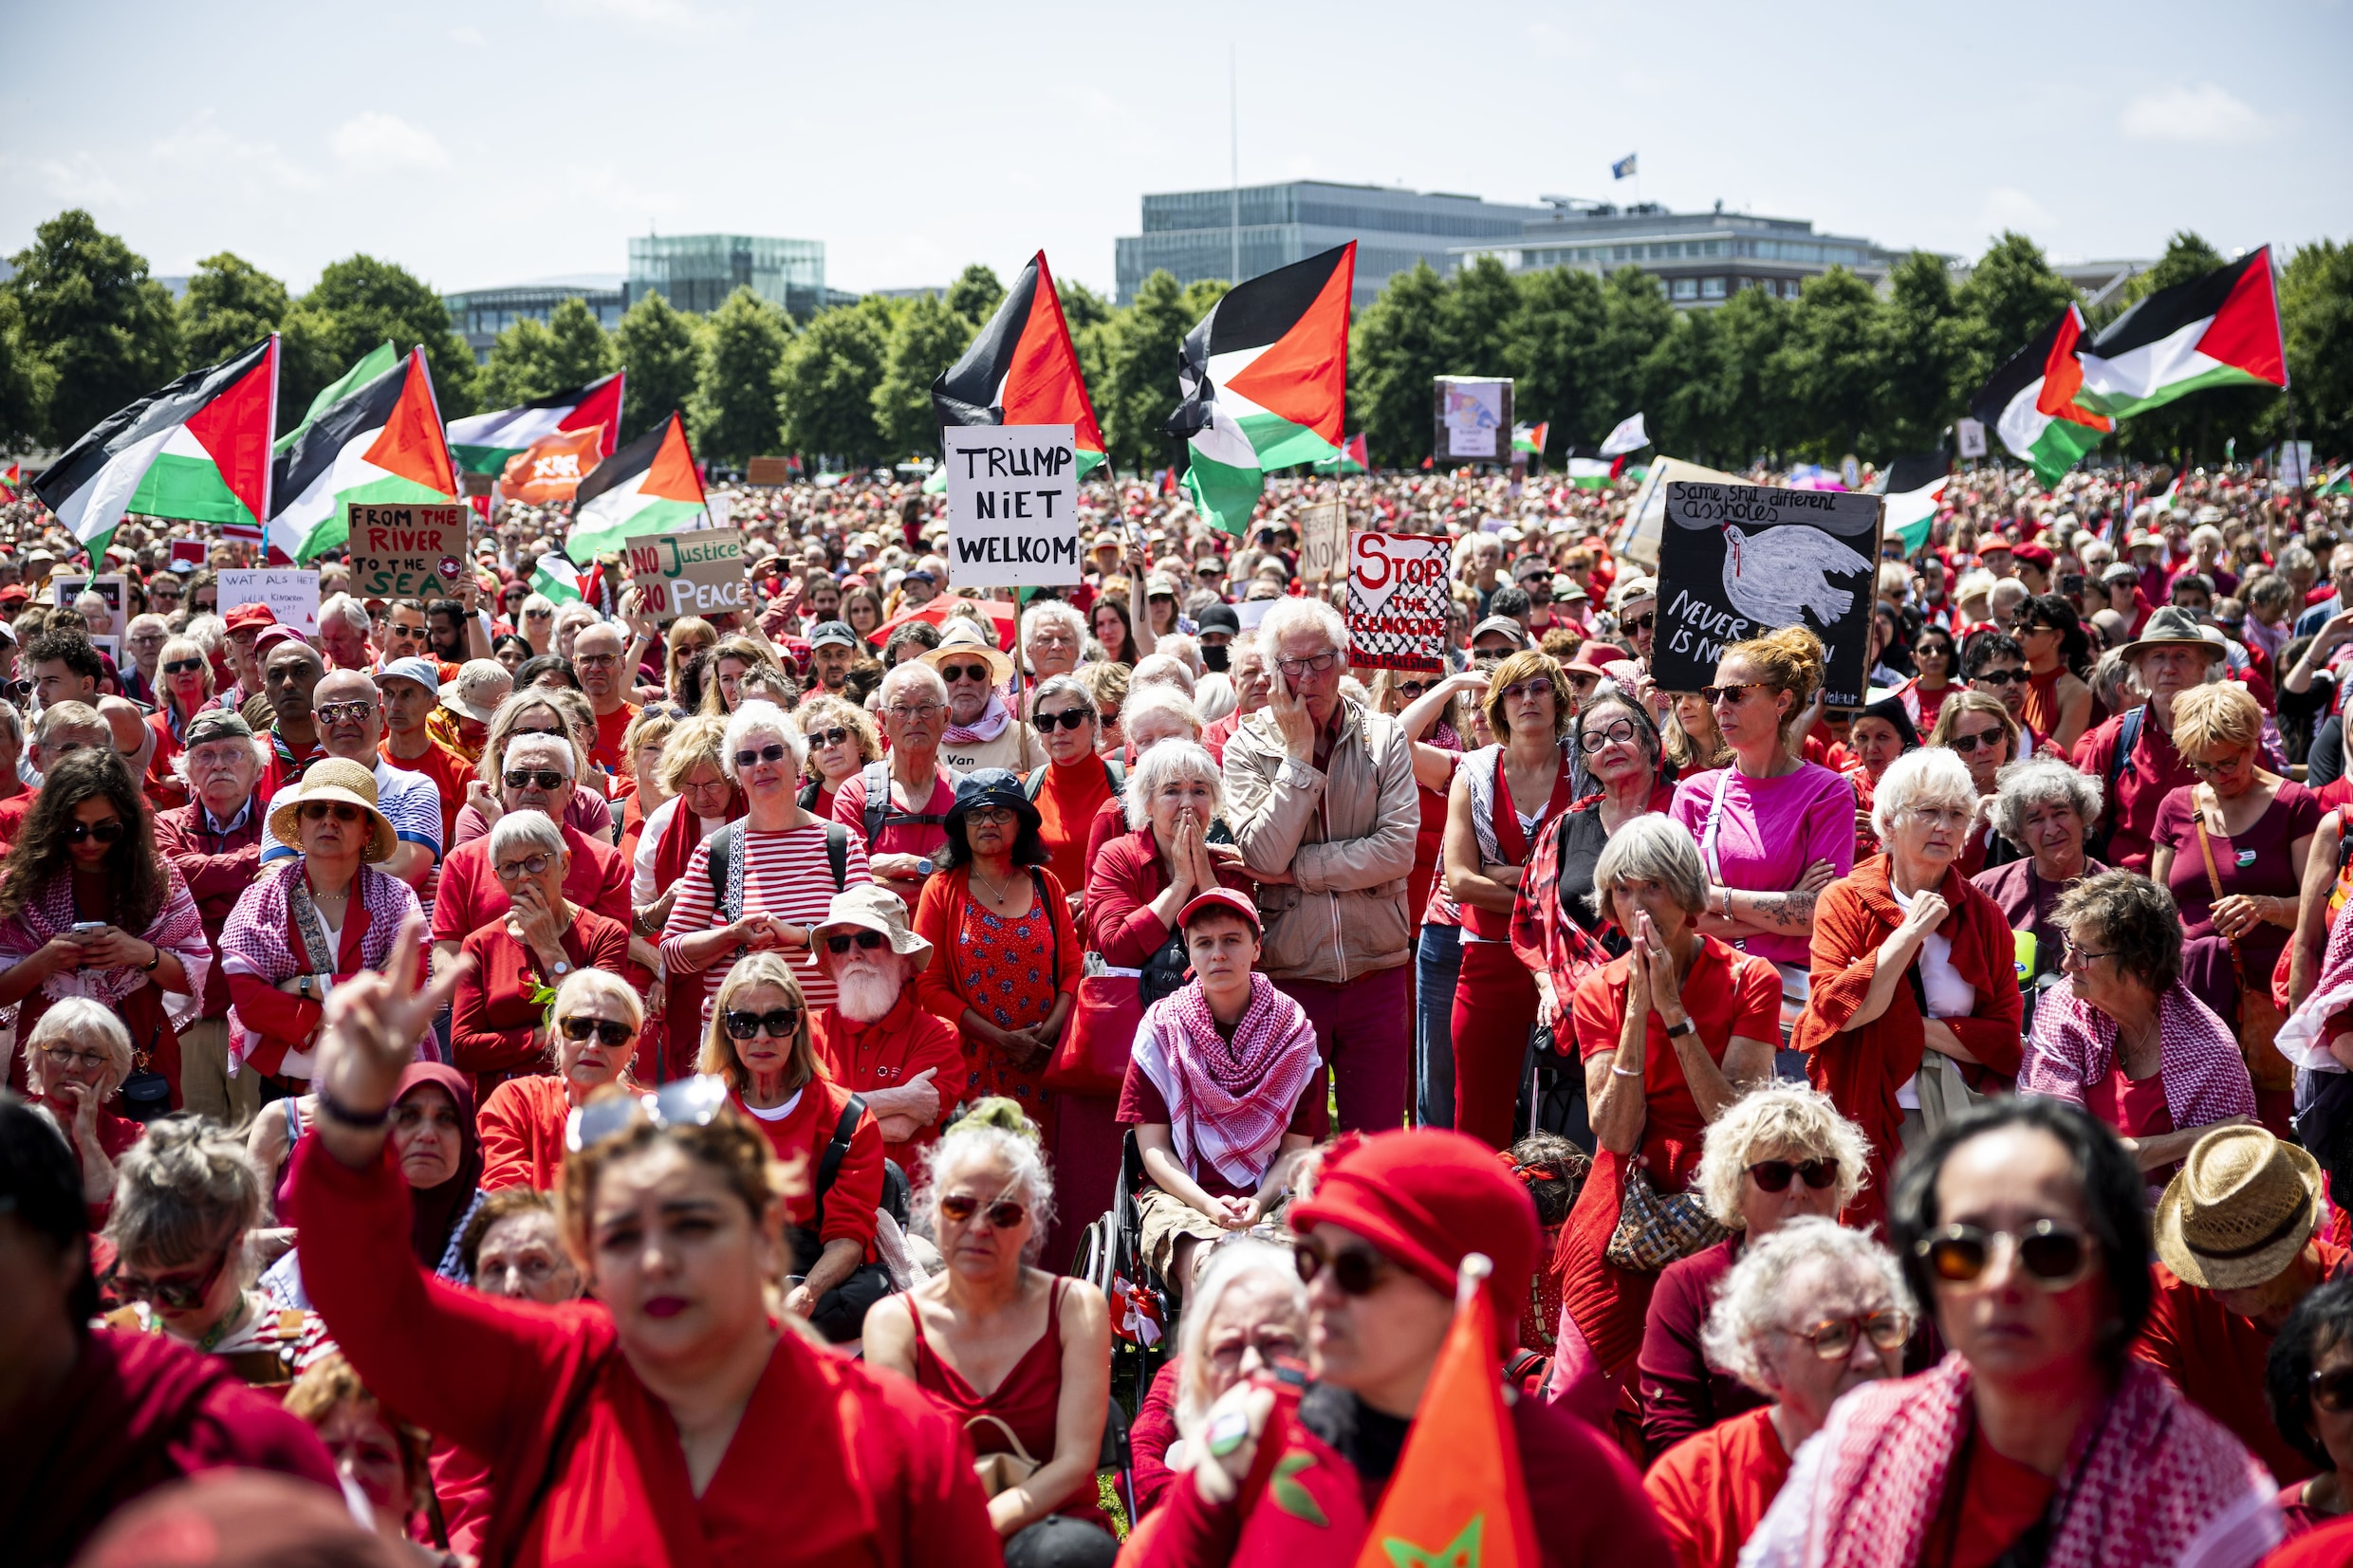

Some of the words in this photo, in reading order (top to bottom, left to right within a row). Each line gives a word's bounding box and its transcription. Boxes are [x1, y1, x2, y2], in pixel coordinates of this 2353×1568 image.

[956, 446, 1072, 479] TRUMP
[1674, 482, 1721, 501] Same
[1769, 490, 1837, 511] different
[351, 507, 412, 528] FROM
[420, 508, 457, 526] THE
[631, 545, 659, 576] NO
[659, 537, 739, 578] Justice
[956, 536, 1077, 565] WELKOM
[1306, 540, 1344, 568] NOW
[353, 557, 380, 575] TO
[387, 558, 426, 574] THE
[225, 575, 257, 586] WAT
[266, 576, 288, 584] ALS
[296, 575, 315, 584] HET
[363, 571, 445, 597] SEA
[637, 583, 666, 615] NO
[1390, 596, 1428, 612] THE
[1352, 613, 1445, 637] GENOCIDE
[1667, 588, 1750, 642] NEVER
[947, 754, 975, 766] Van
